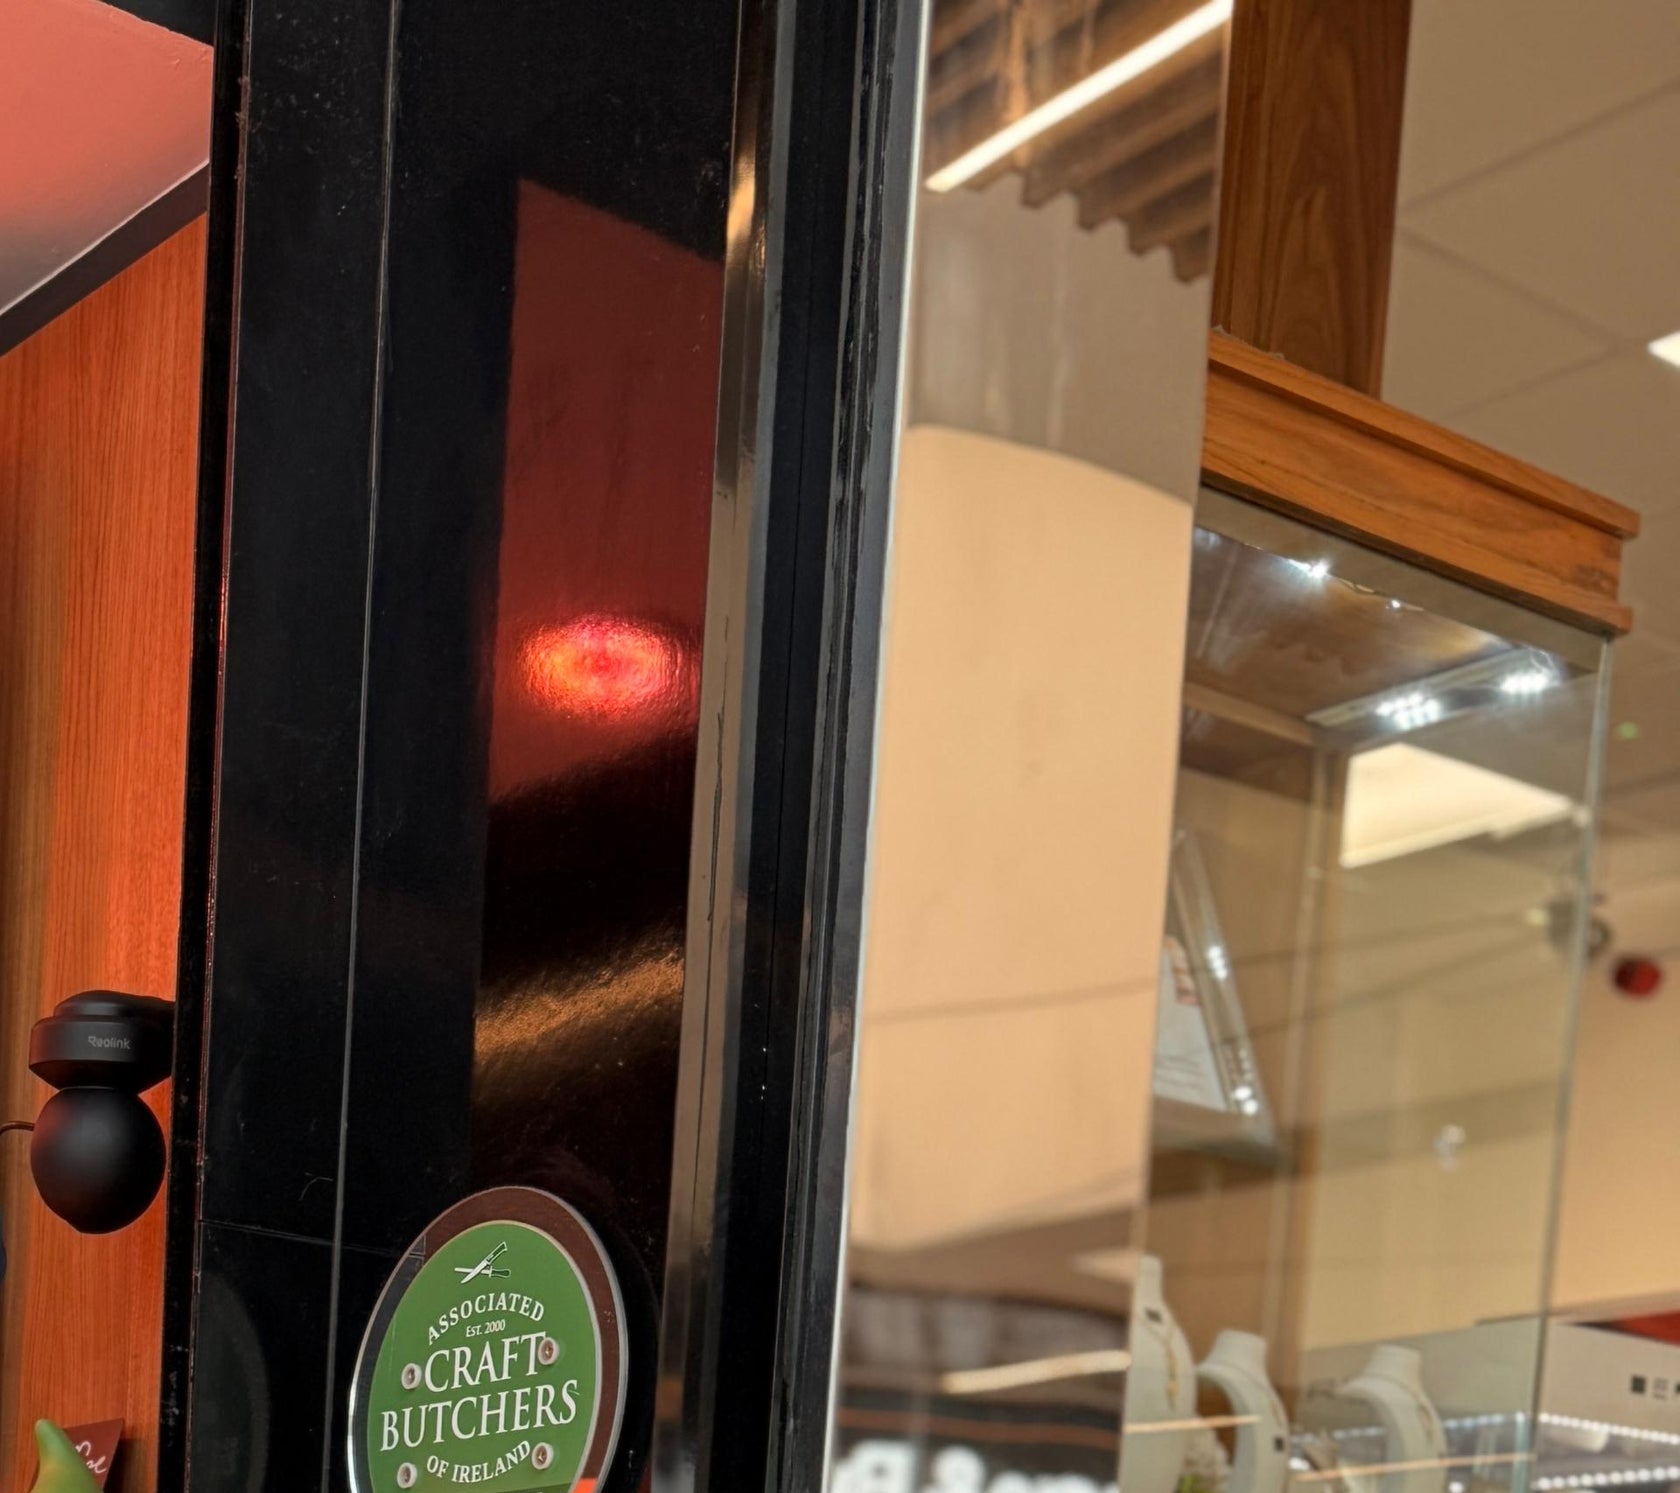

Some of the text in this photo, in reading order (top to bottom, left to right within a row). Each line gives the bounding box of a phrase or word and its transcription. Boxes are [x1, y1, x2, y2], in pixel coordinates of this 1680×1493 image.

[427, 1292, 545, 1346] ASSOCIATED
[465, 1319, 506, 1338] EST. 2000
[424, 1331, 547, 1394] CRAFT
[380, 1379, 579, 1452] BUTCHERS
[426, 1440, 532, 1485] OF IRELAND
